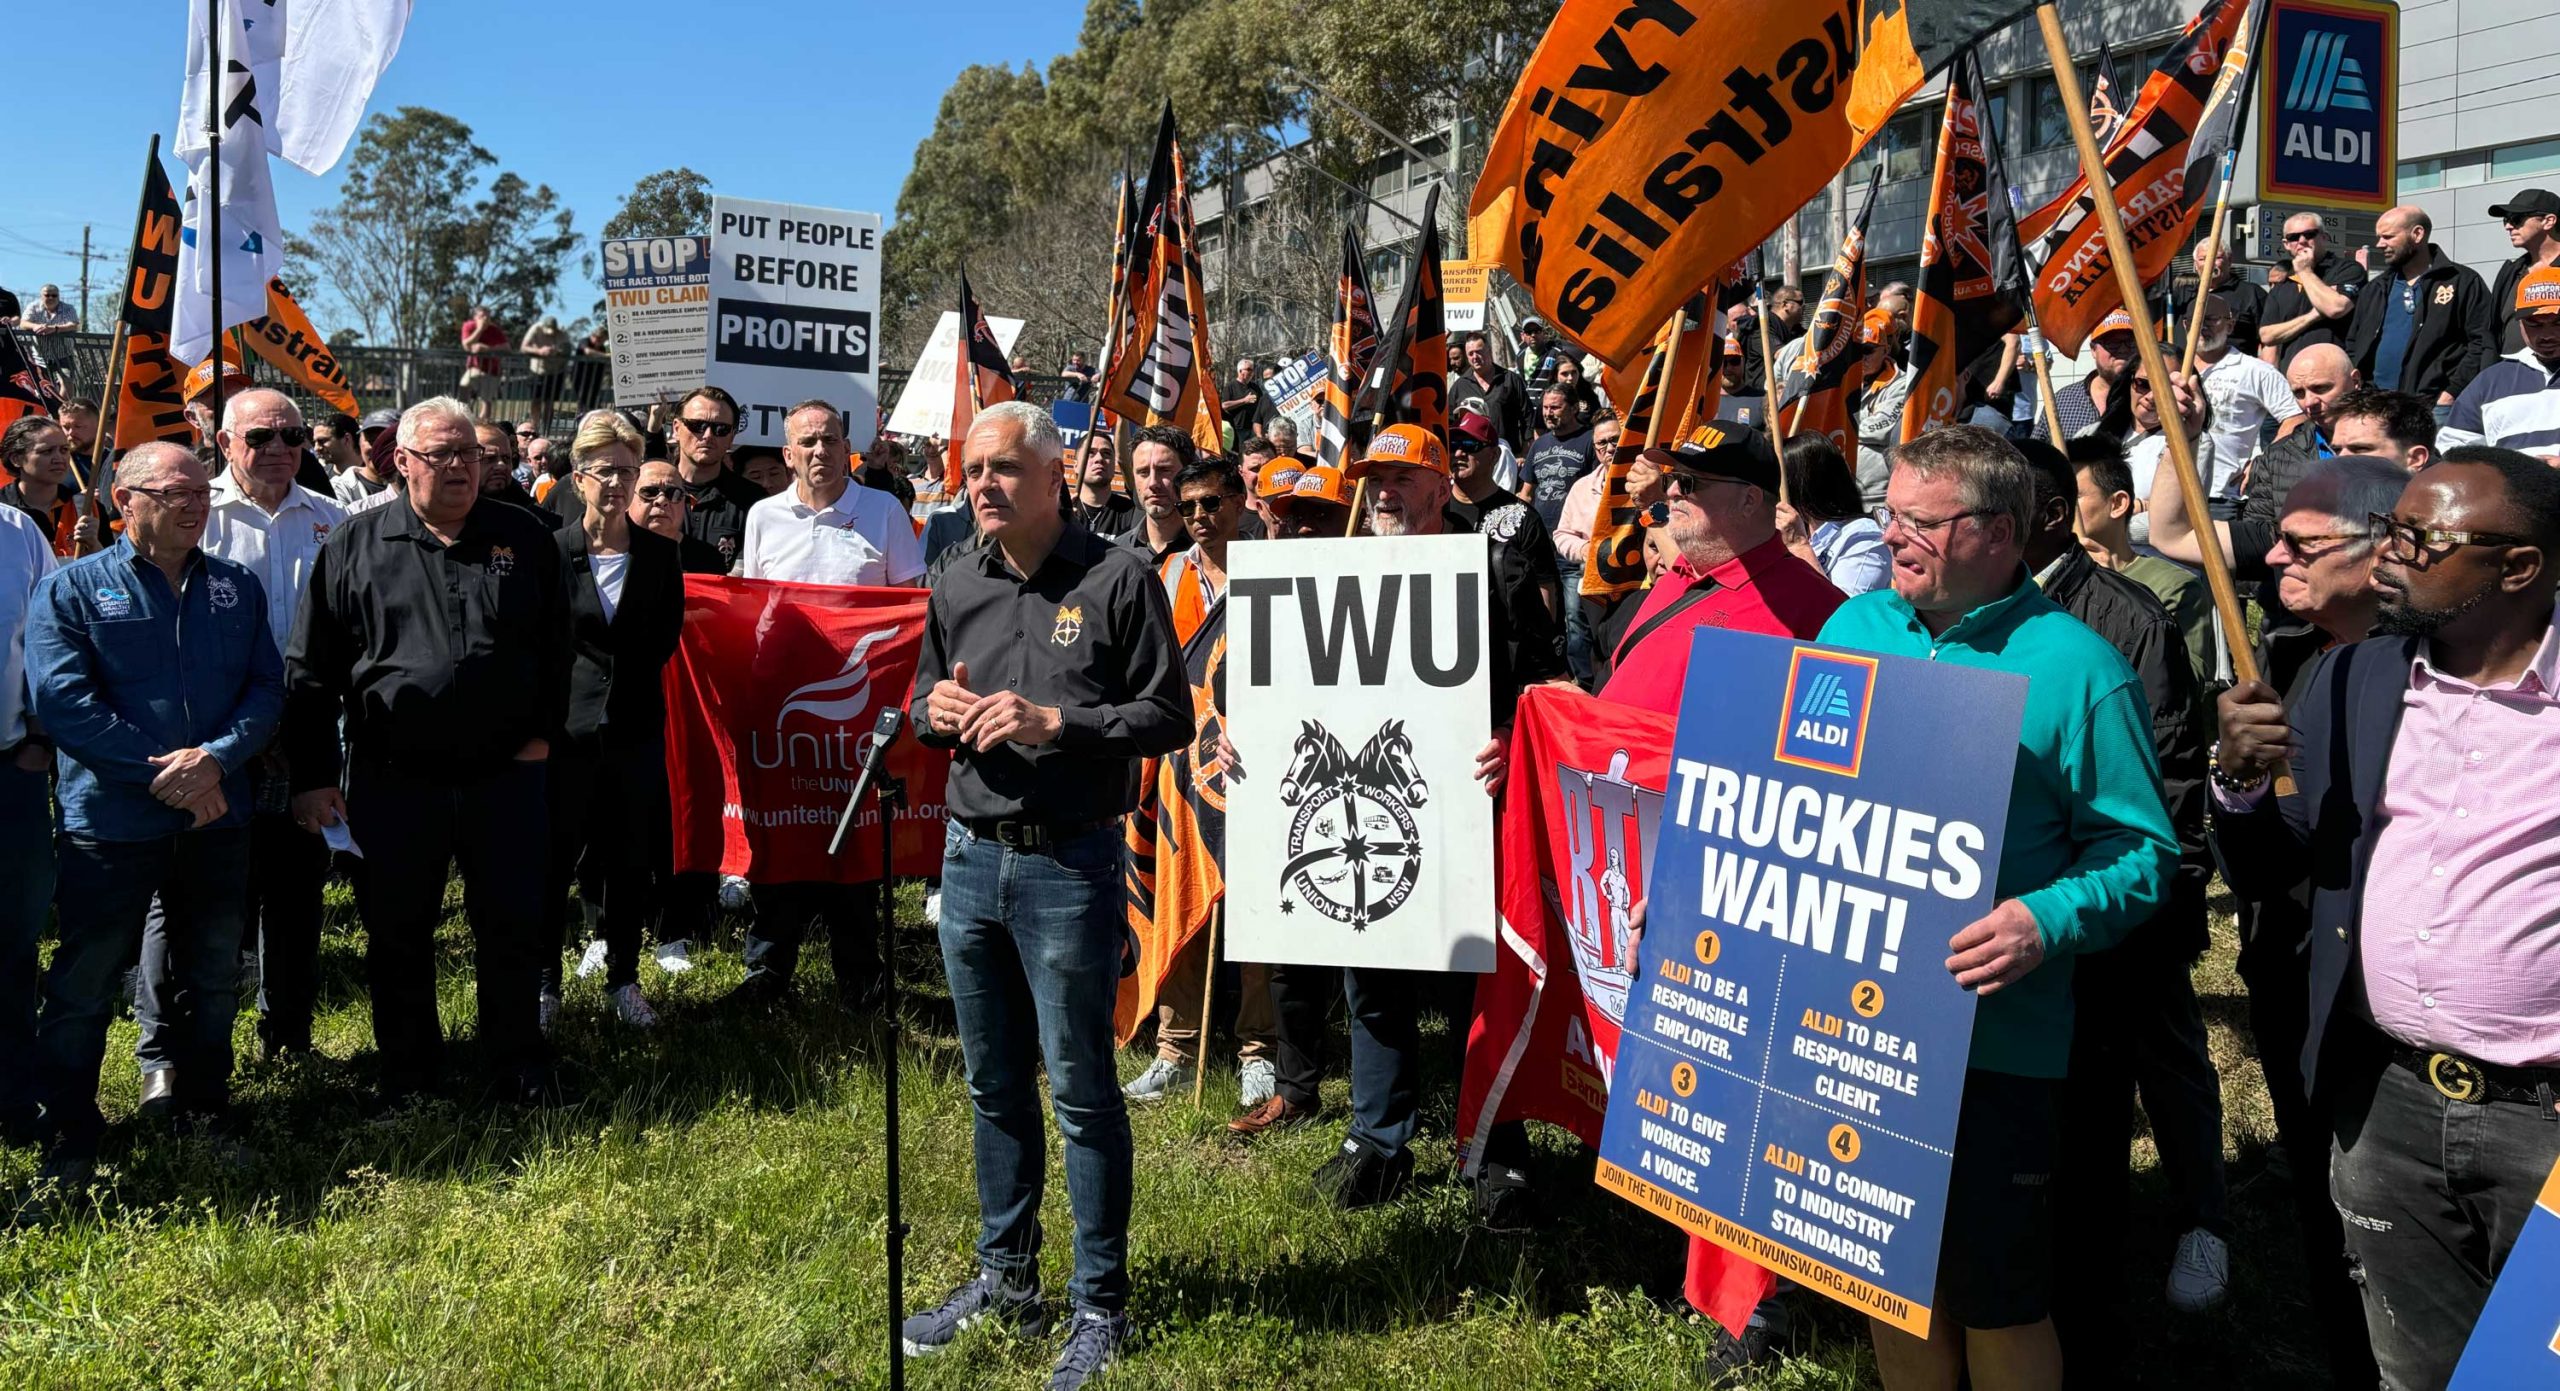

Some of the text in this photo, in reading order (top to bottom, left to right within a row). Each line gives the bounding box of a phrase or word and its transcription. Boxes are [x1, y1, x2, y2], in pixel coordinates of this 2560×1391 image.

[2283, 123, 2372, 166] ALDI
[721, 213, 874, 250] PUT PEOPLE
[604, 238, 697, 275] STOP
[735, 254, 858, 292] BEFORE
[608, 279, 625, 287] THE
[629, 277, 653, 286] RACE
[656, 276, 667, 284] TO
[668, 275, 685, 284] THE
[608, 291, 650, 307] TWU
[720, 314, 867, 357] PROFITS
[1446, 309, 1474, 319] TWU
[1264, 359, 1309, 399] STOP
[1279, 398, 1300, 414] TWU
[1229, 572, 1480, 688] TWU
[752, 725, 874, 771] unite
[1795, 719, 1850, 748] ALDI
[1290, 785, 1334, 854] TRANSPORT
[1675, 758, 1985, 901] TRUCKIES
[1297, 875, 1412, 917] UNION NSW
[1700, 847, 1909, 973] WANT!
[1703, 936, 1714, 957] 1
[1660, 958, 1748, 1007] ALDI TO BE A
[1858, 986, 1876, 1012] 2
[1651, 983, 1748, 1037] RESPONSIBLE
[1654, 1015, 1733, 1061] EMPLOYER.
[1801, 1008, 1918, 1064] ALDI TO BE A
[1677, 1068, 1691, 1091] 3
[1792, 1035, 1919, 1097] RESPONSIBLE
[1636, 1088, 1727, 1144] ALDI TO GIVE
[1815, 1076, 1882, 1117] CLIENT.
[1640, 1119, 1711, 1167] WORKERS
[1835, 1129, 1851, 1157] 4
[1640, 1149, 1699, 1194] A VOICE.
[1763, 1143, 1915, 1221] ALDI TO COMMIT
[1775, 1176, 1894, 1245] TO INDUSTRY
[1601, 1164, 1909, 1320] JOIN THE TWU TODAY WWW.TWUNSW.ORG.AU/JOIN
[1771, 1212, 1885, 1276] STANDARDS.
